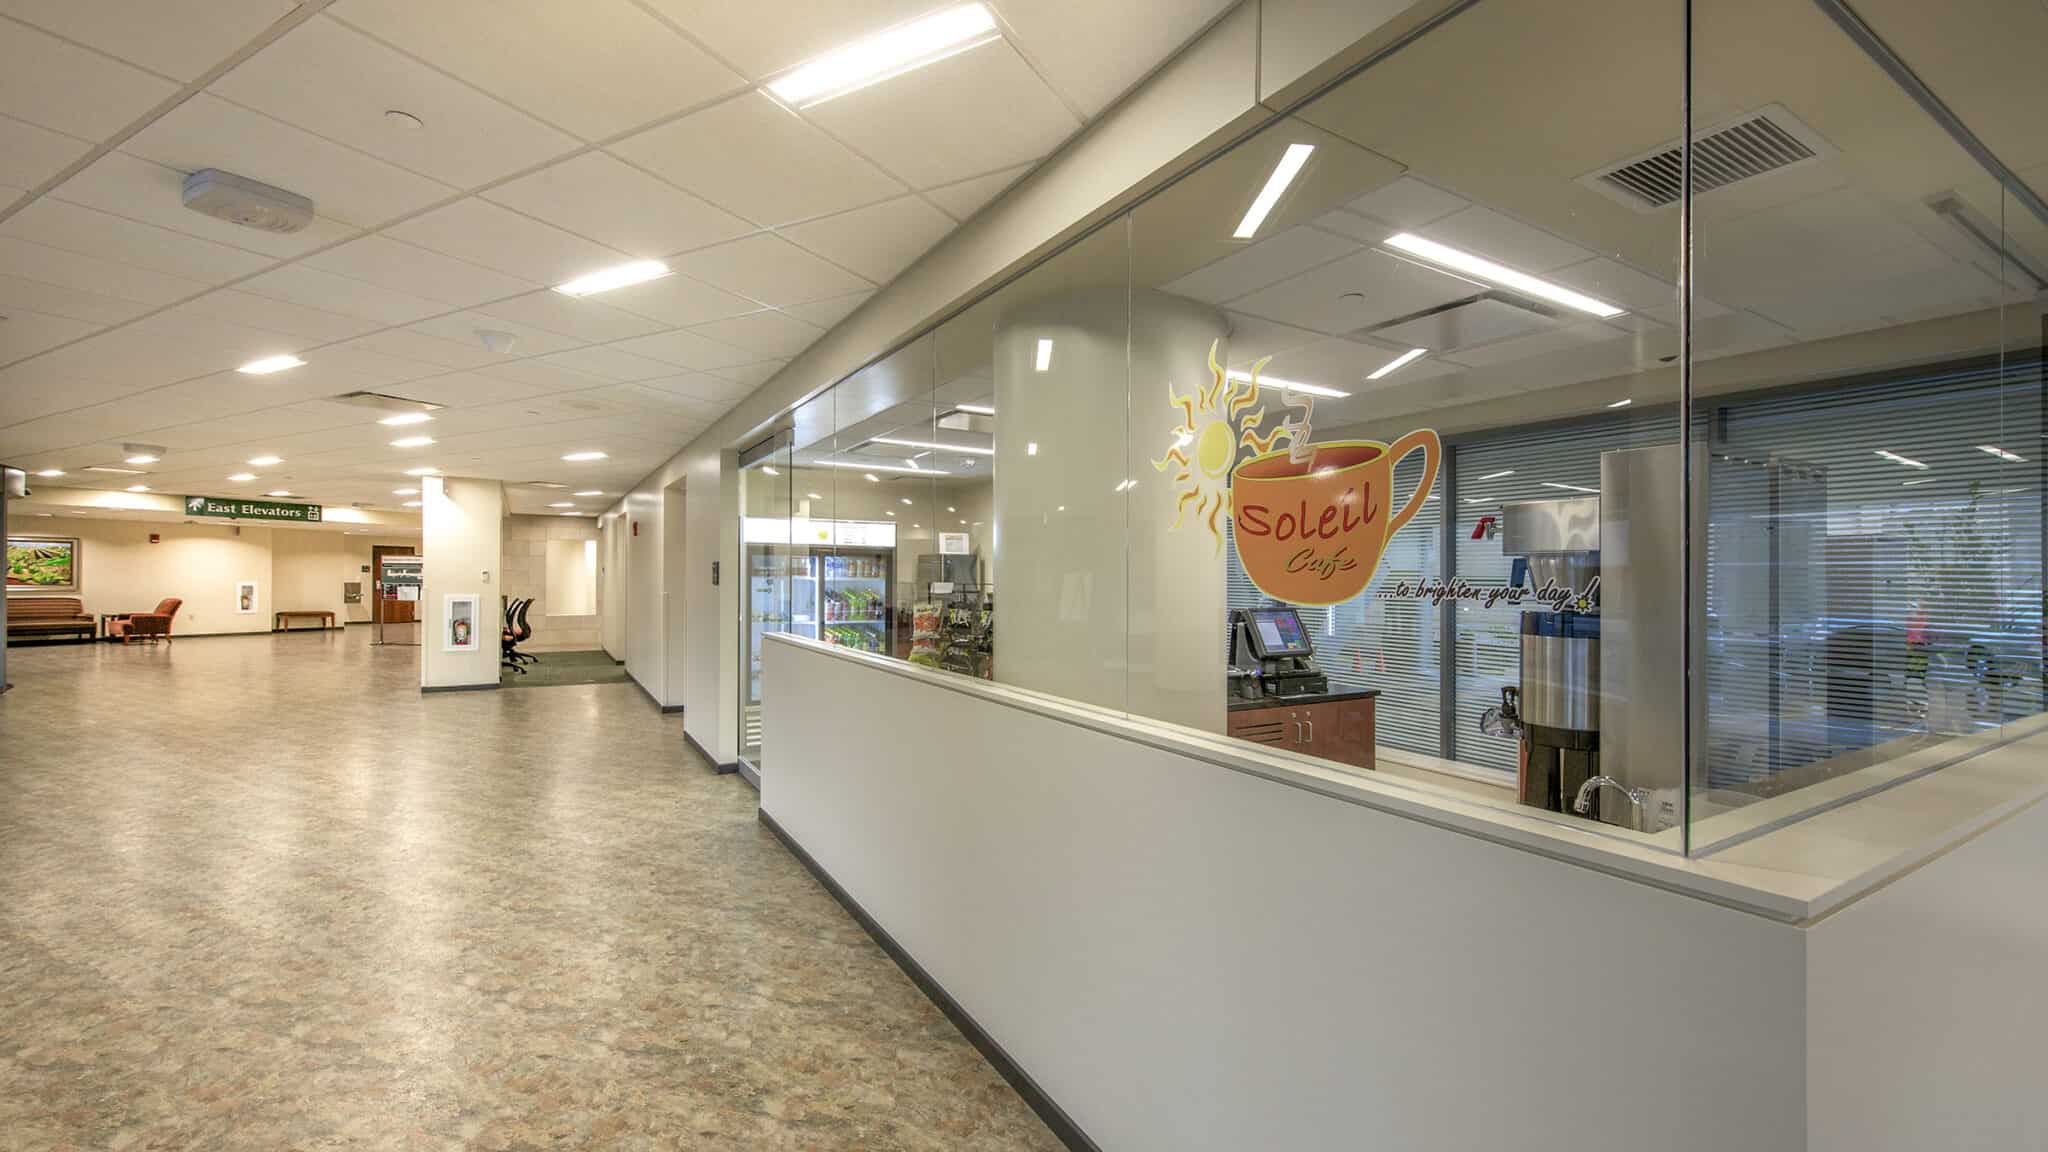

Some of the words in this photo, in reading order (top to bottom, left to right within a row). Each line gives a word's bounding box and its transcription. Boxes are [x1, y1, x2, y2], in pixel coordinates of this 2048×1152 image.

[207, 502, 236, 513] East
[241, 504, 301, 517] Elevators
[1415, 577, 1481, 606] brighten
[1484, 587, 1530, 608] your
